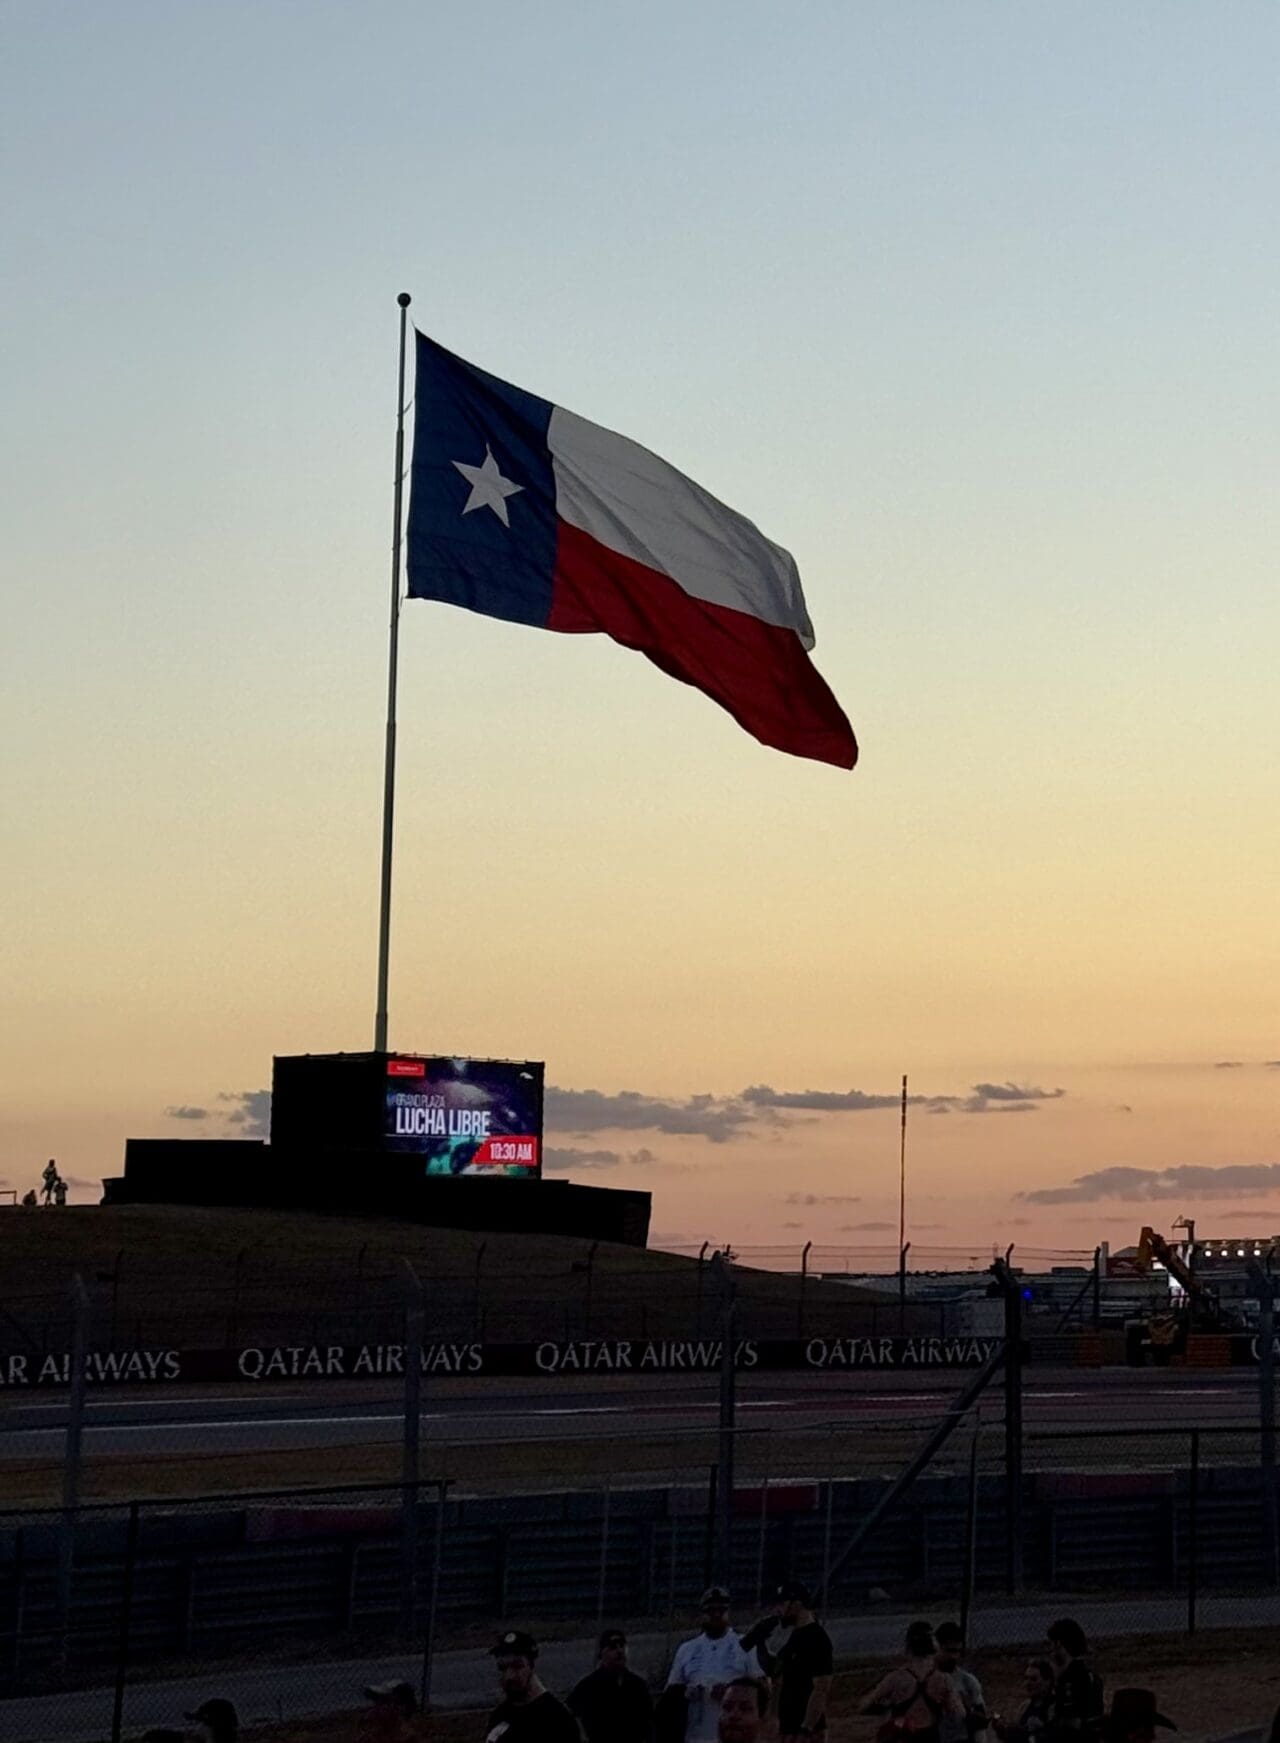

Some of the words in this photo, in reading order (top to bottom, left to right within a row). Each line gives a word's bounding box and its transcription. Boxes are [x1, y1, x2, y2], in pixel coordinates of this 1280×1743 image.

[422, 1095, 445, 1108] PLAZA
[396, 1107, 446, 1135] LUCHA
[449, 1109, 491, 1136] LIBRE
[517, 1143, 532, 1160] AM
[238, 1347, 345, 1379] QATAR
[535, 1341, 632, 1371] QATAR
[806, 1338, 894, 1366] QATAR
[902, 1338, 1000, 1363] AIRWAY
[0, 1354, 29, 1384] R
